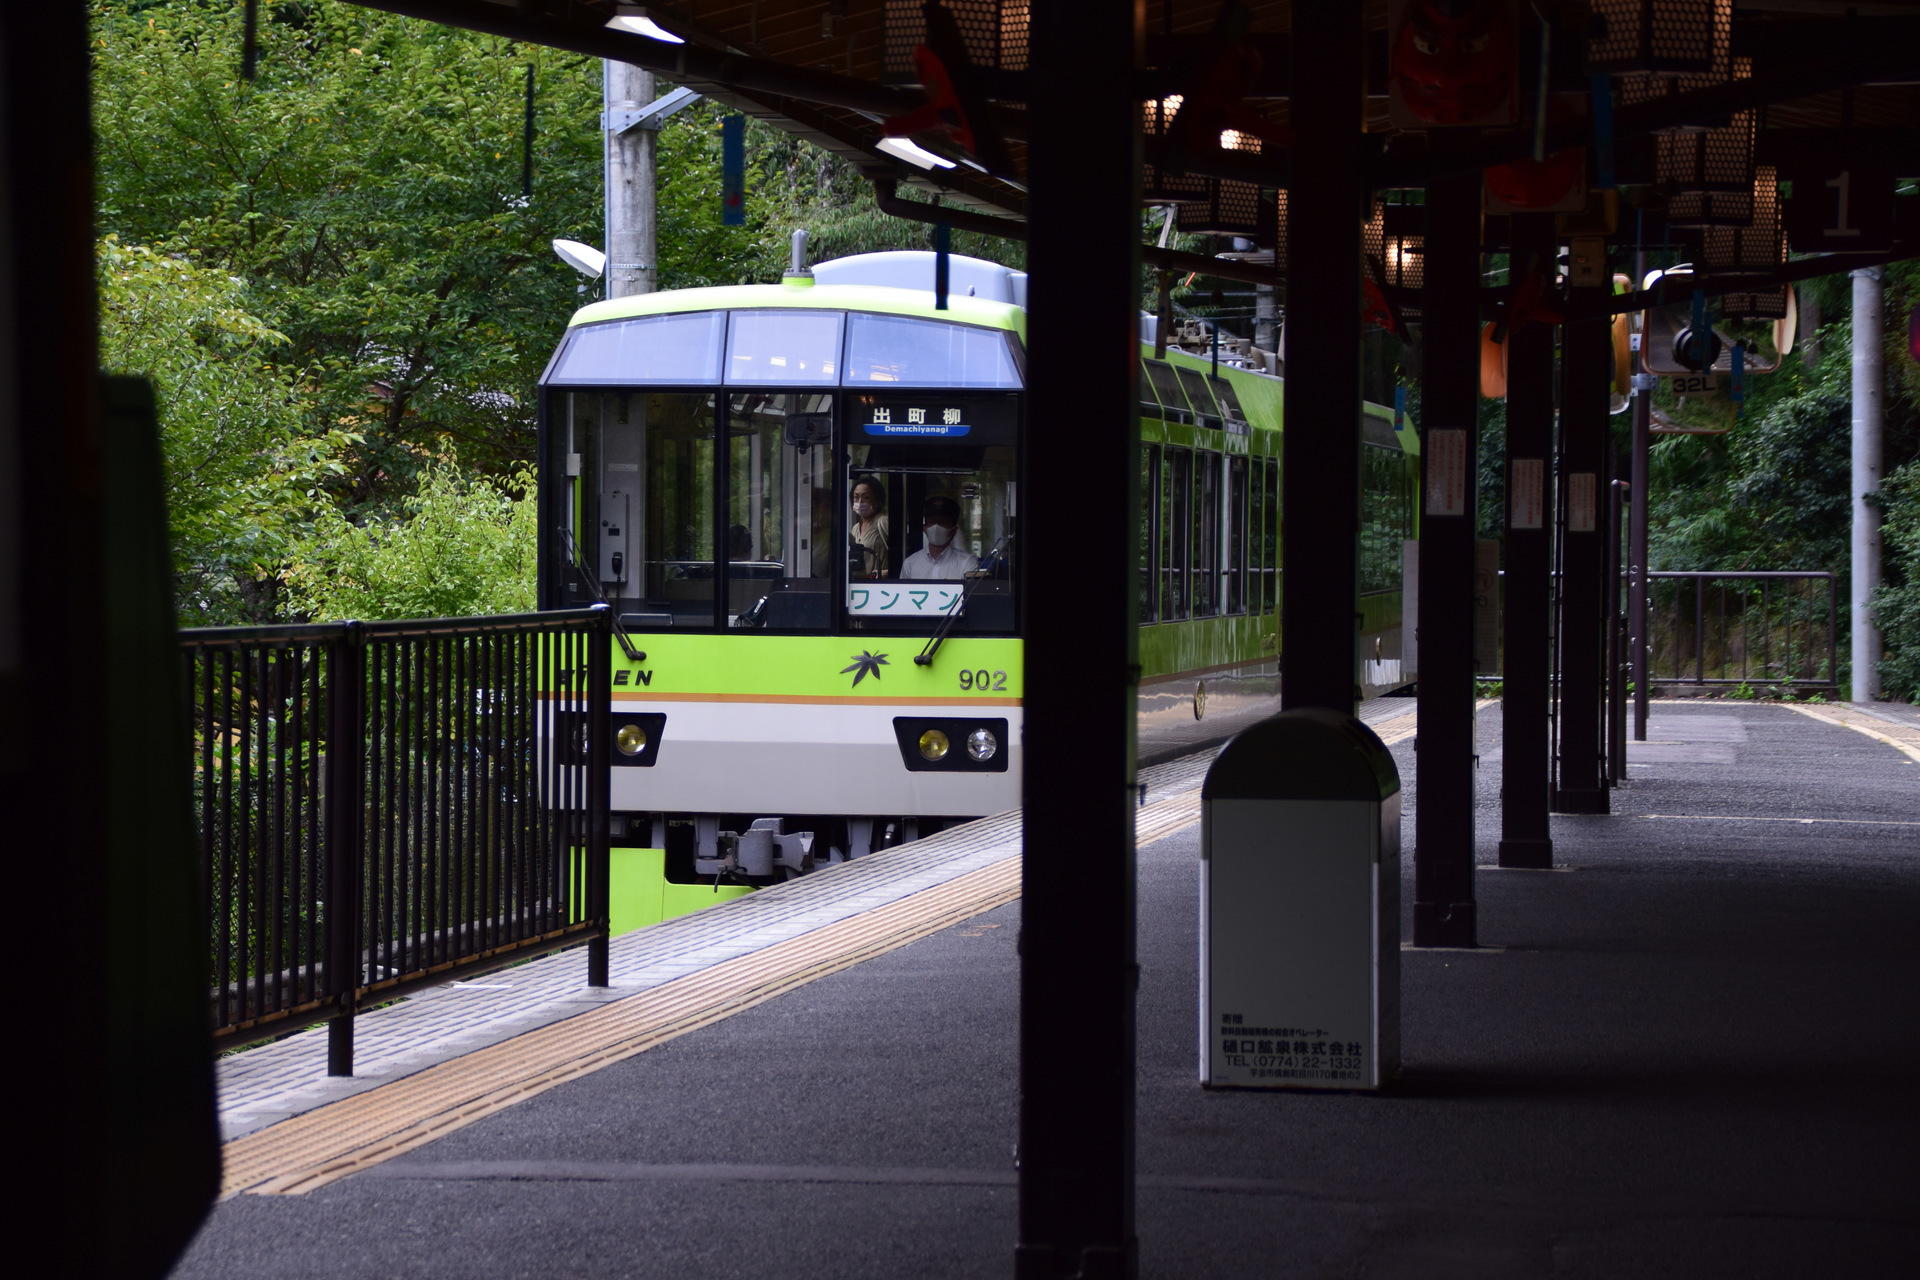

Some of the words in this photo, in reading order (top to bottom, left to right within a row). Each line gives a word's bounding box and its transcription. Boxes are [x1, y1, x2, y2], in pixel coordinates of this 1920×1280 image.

[1823, 170, 1861, 237] 1
[1672, 377, 1716, 393] 32L
[873, 407, 961, 424] 出町柳
[884, 425, 949, 434] Demachiyanagi
[850, 590, 958, 610] ワンマン
[959, 669, 1007, 690] 902
